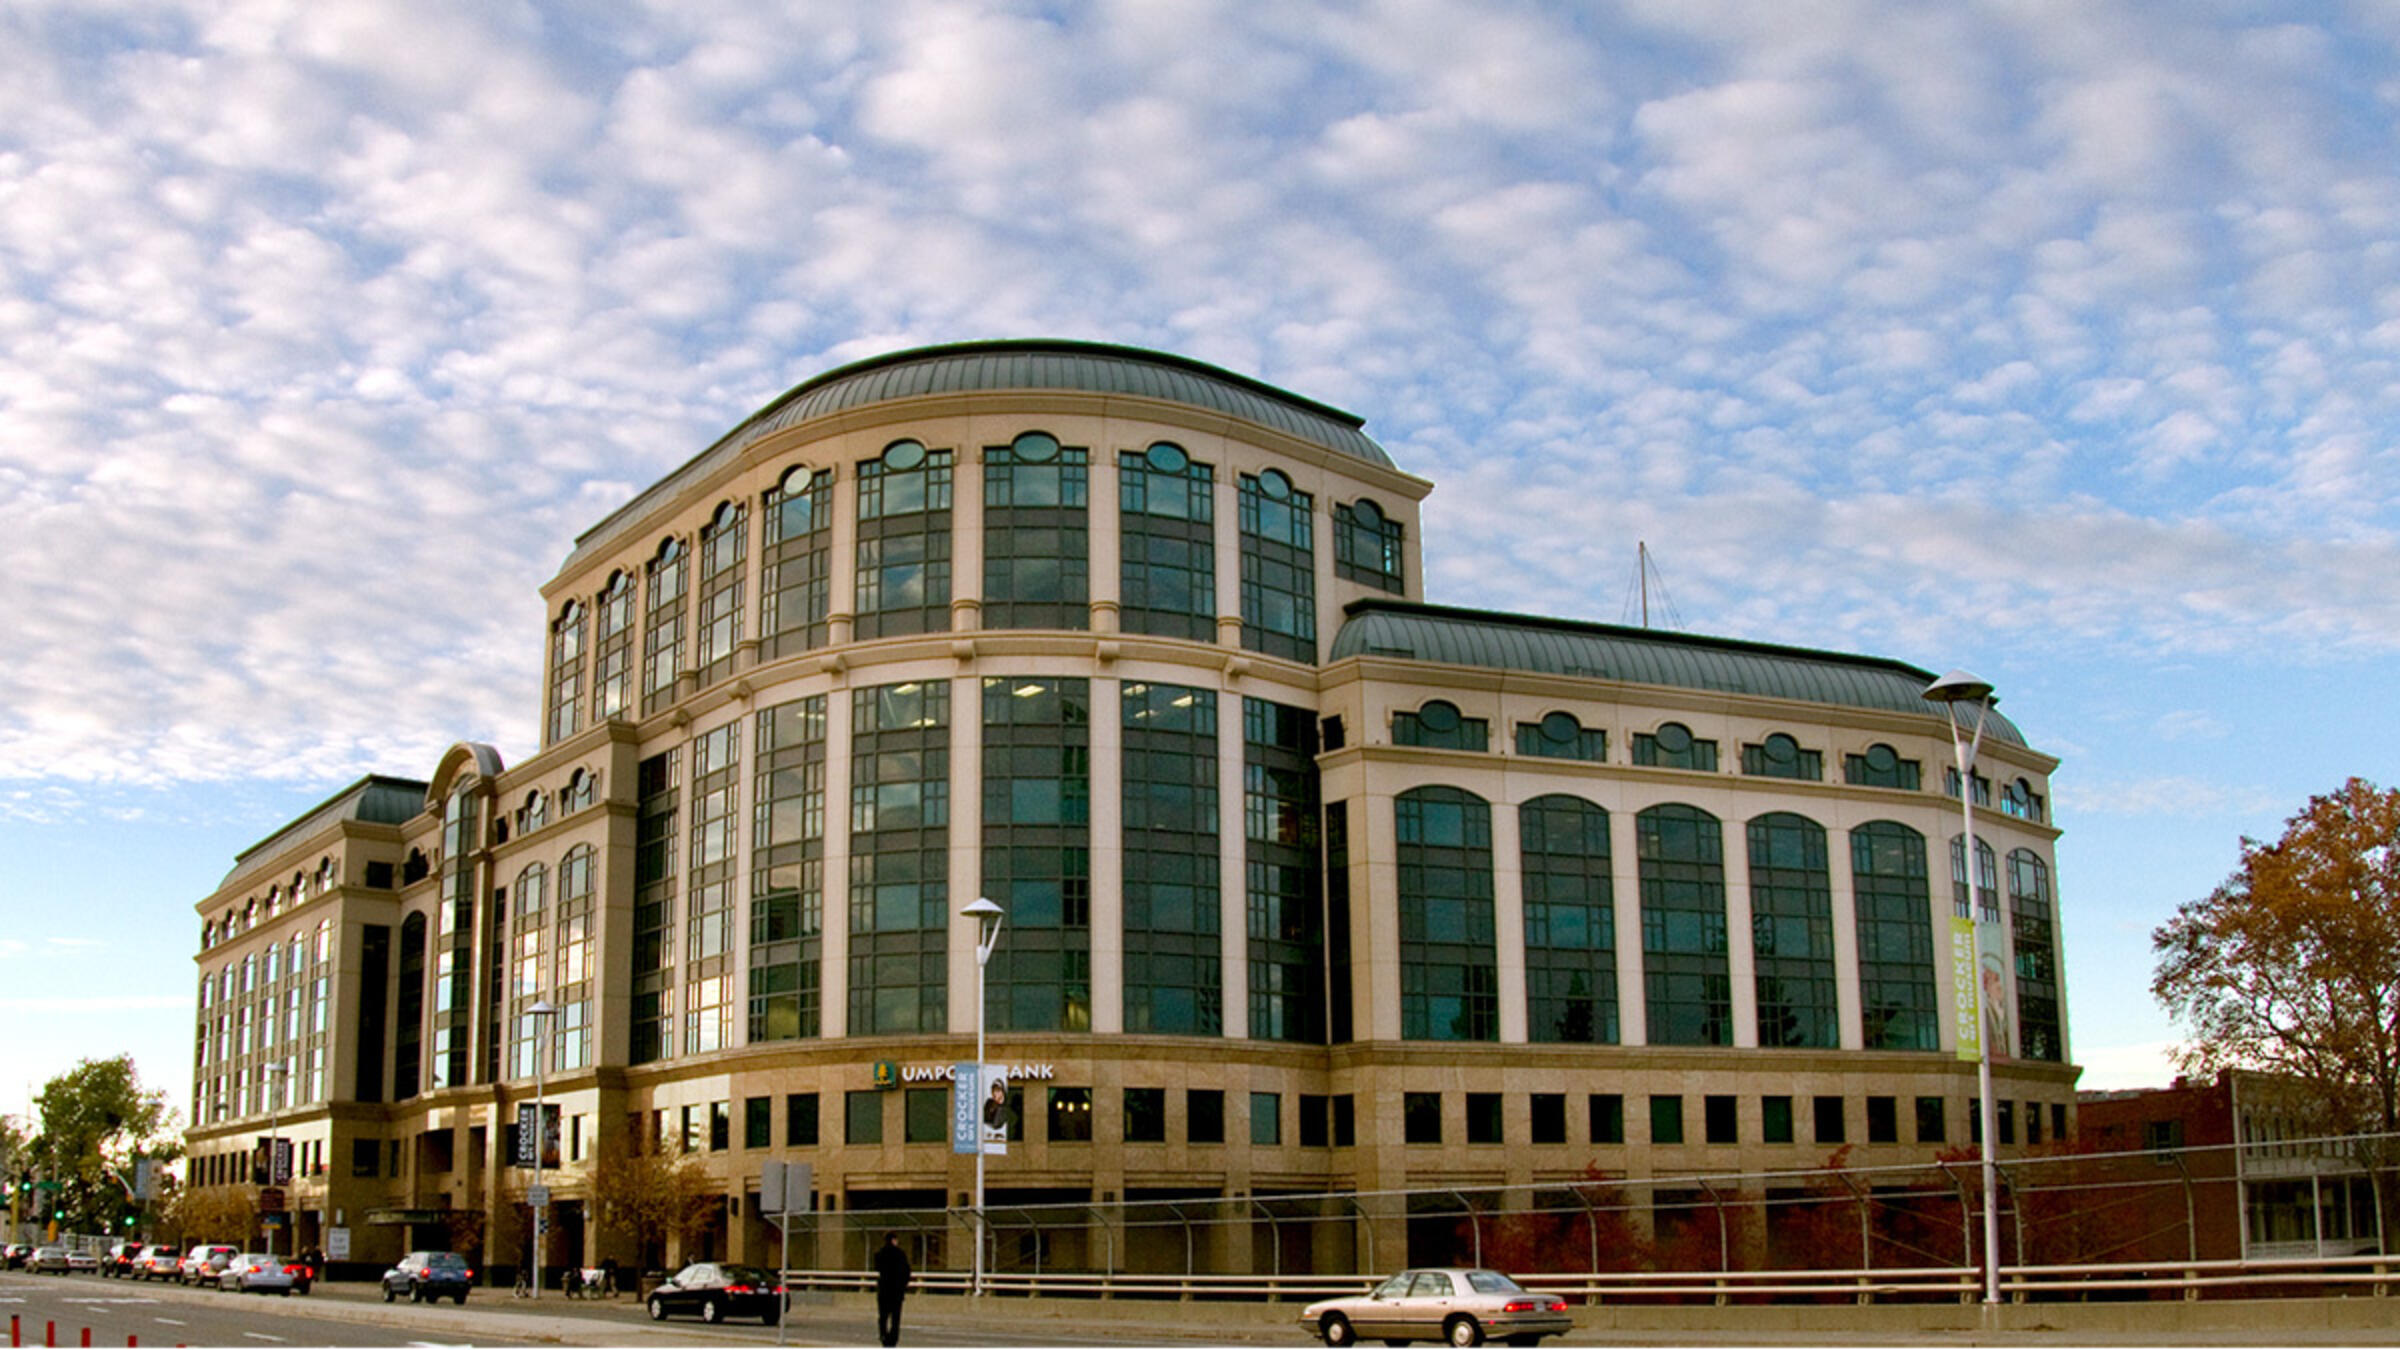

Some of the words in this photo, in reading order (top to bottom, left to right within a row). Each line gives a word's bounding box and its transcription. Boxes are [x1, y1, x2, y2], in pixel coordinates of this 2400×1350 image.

[1953, 932, 1969, 1040] CROCKER
[902, 1065, 956, 1081] UMP
[1008, 1064, 1054, 1079] ANK
[957, 1072, 968, 1140] CROCKER
